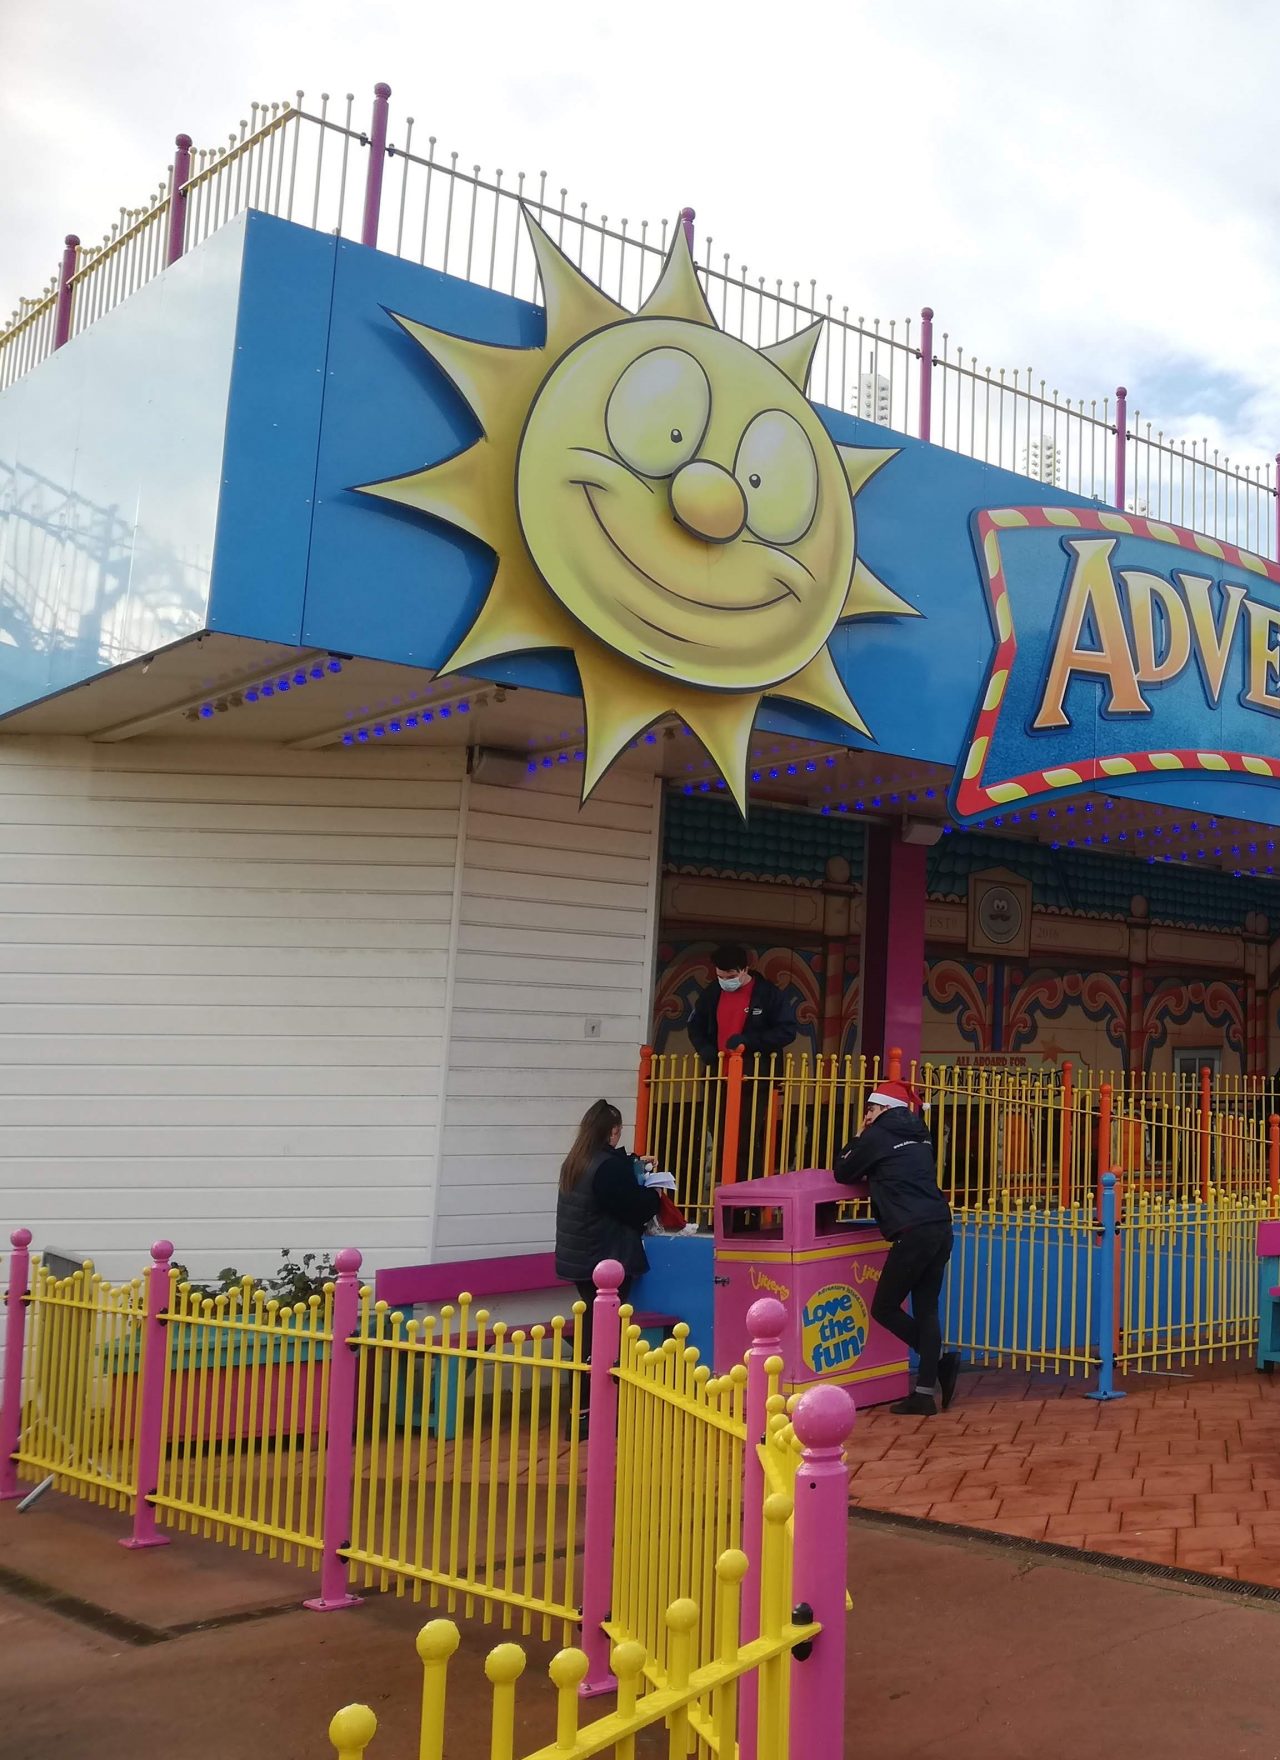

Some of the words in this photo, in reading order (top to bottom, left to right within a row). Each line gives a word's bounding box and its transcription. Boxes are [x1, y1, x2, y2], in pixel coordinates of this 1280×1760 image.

[956, 1056, 970, 1067] ALL
[973, 1056, 1007, 1067] ABOARD
[1010, 1056, 1027, 1067] FOR
[802, 1294, 853, 1328] Love
[819, 1315, 856, 1343] the
[812, 1326, 865, 1373] fun!
